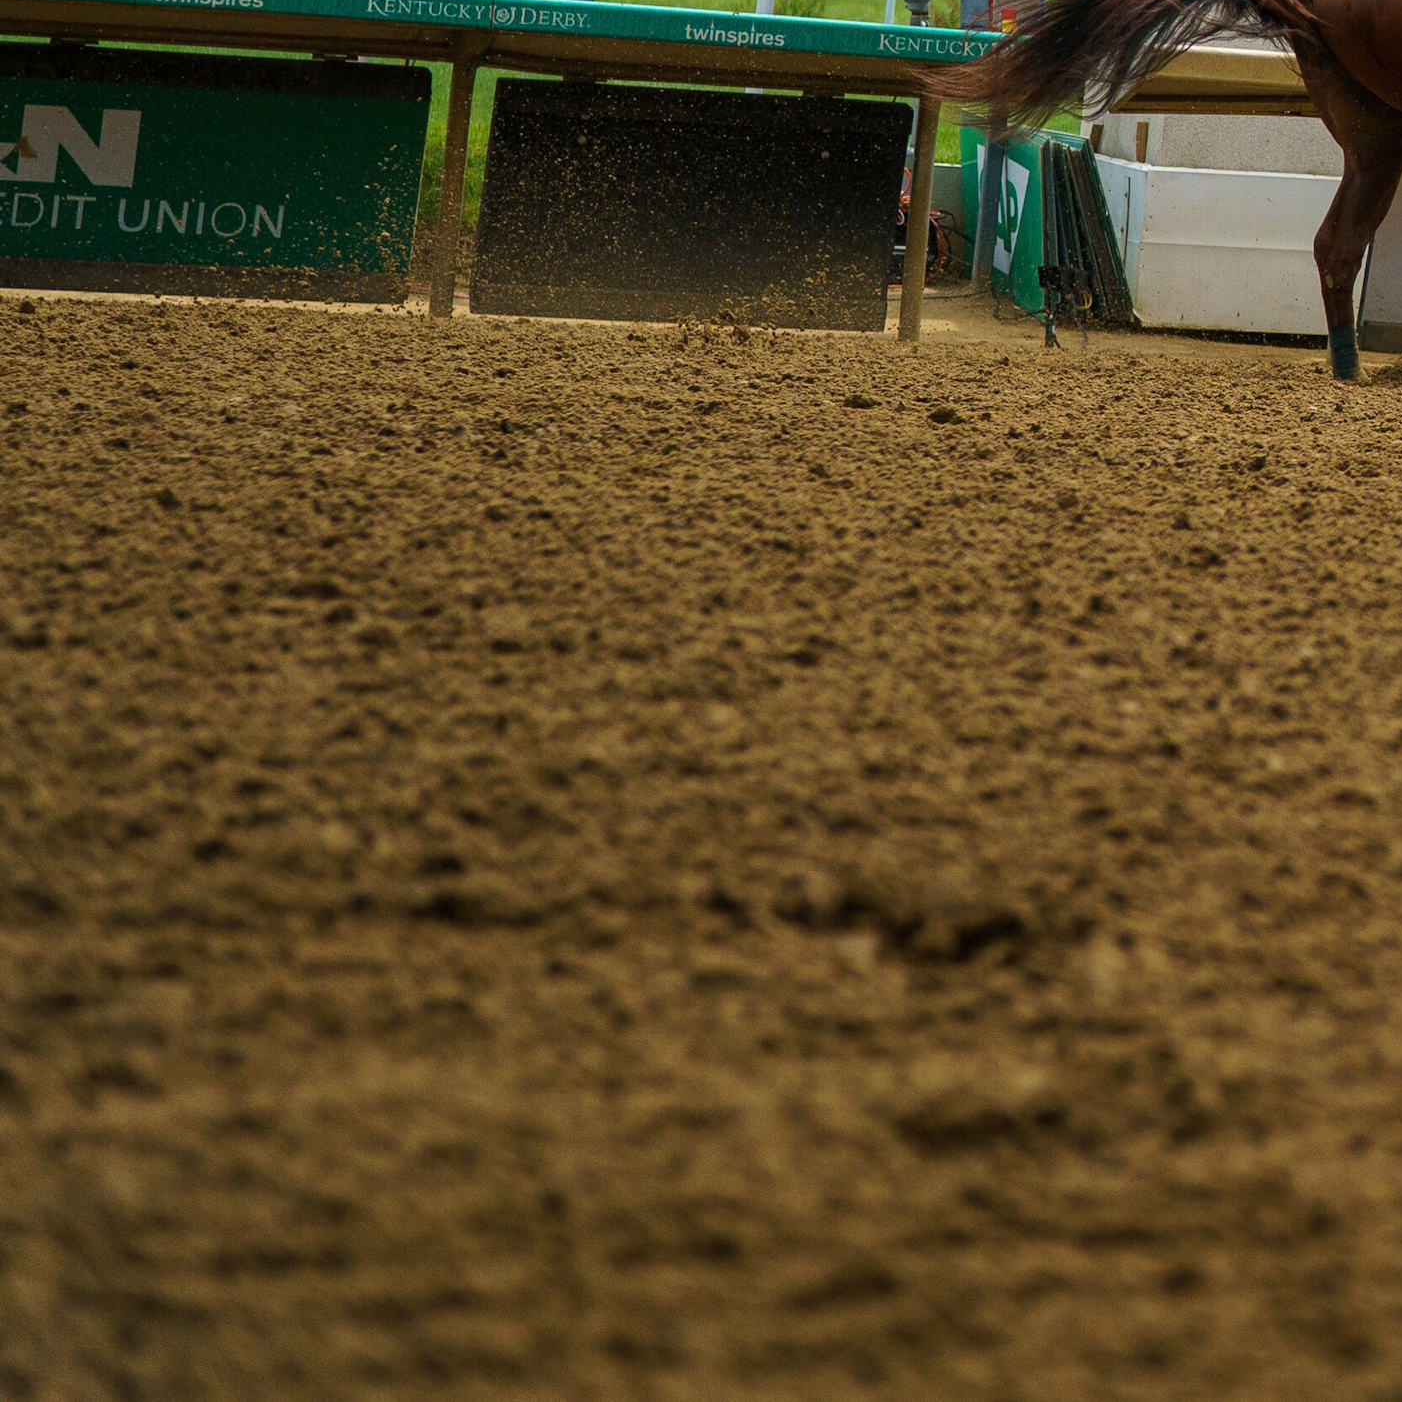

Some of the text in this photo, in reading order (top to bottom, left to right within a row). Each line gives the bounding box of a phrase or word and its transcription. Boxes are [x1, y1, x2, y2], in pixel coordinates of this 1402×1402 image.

[520, 7, 588, 30] DERBY
[685, 20, 786, 47] twinspires
[878, 33, 989, 57] KENTUCKY
[0, 192, 285, 238] DIT UNION
